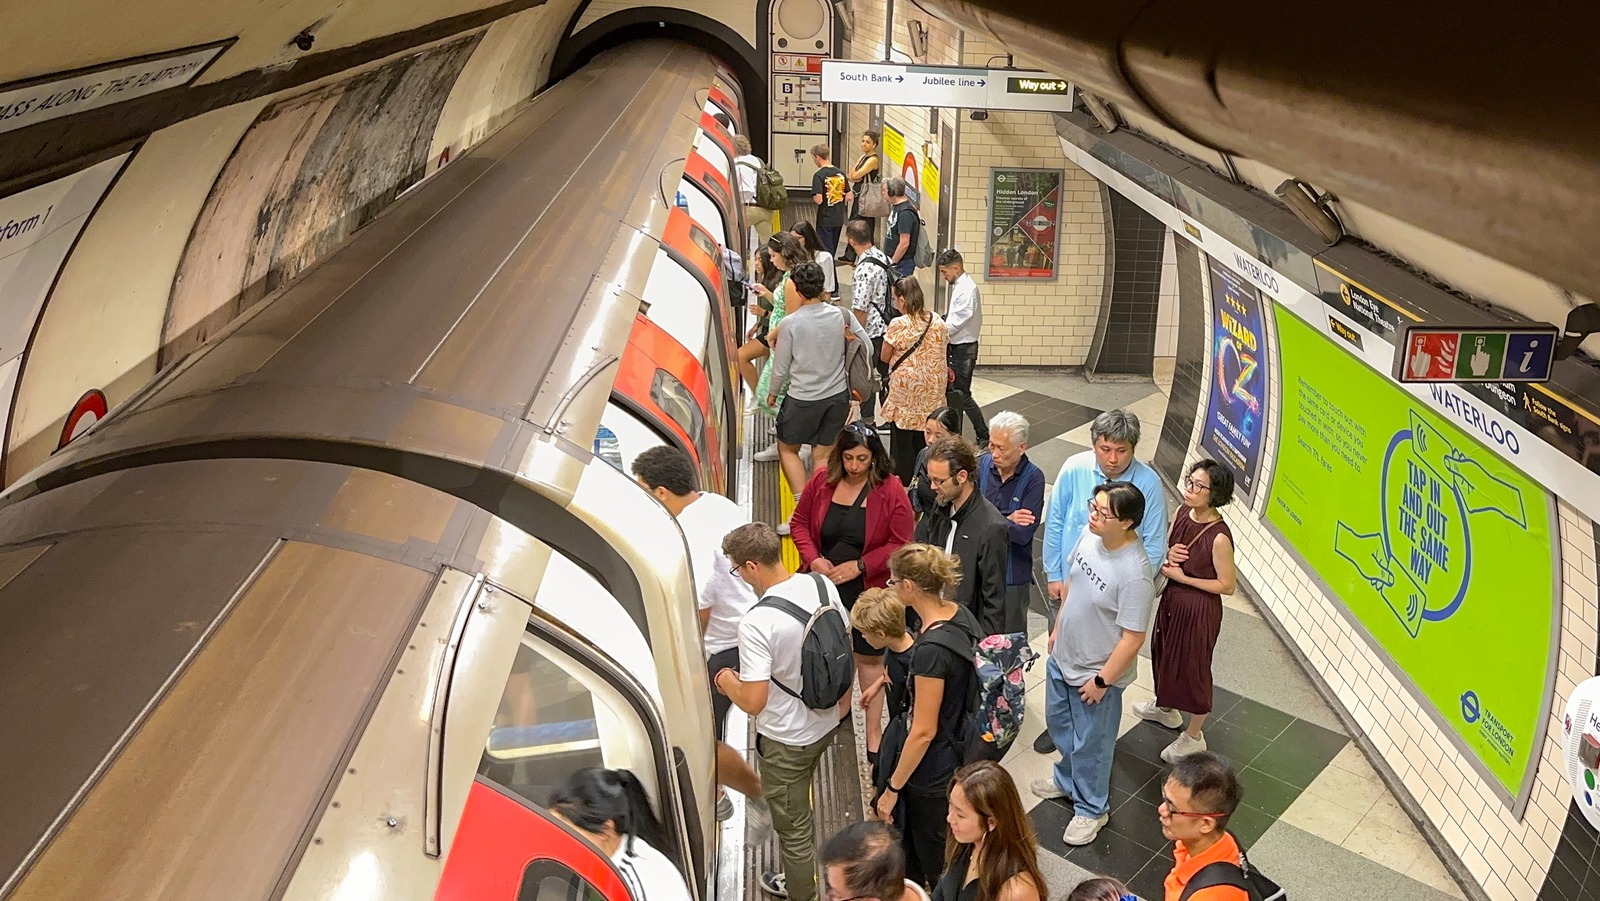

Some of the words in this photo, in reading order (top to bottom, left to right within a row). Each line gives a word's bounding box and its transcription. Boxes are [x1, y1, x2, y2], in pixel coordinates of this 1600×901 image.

[31, 83, 103, 113] ALONG
[99, 75, 137, 96] THE
[131, 61, 203, 89] PLATFORM
[784, 84, 791, 93] B
[840, 72, 868, 82] South
[871, 74, 893, 83] Bank
[922, 76, 956, 86] Jubilee
[958, 77, 976, 87] line
[1019, 79, 1040, 92] Way
[1040, 81, 1057, 91] out
[41, 204, 54, 225] 1
[1233, 251, 1279, 294] WATERLOO
[1350, 288, 1370, 308] London
[1368, 299, 1380, 314] Eye
[1352, 300, 1375, 321] National
[1373, 312, 1396, 333] Theatre
[1334, 321, 1347, 338] Way
[1346, 329, 1357, 343] out
[1298, 375, 1322, 401] Remember
[1322, 396, 1329, 407] to
[1328, 402, 1344, 418] touch
[1298, 388, 1307, 401] the
[1306, 396, 1319, 411] same
[1319, 407, 1330, 421] card
[1330, 416, 1337, 426] or
[1336, 421, 1353, 440] device
[1353, 435, 1364, 449] you
[1298, 401, 1317, 422] touched
[1335, 433, 1342, 443] so
[1342, 439, 1353, 452] you
[1352, 448, 1368, 465] never
[1429, 383, 1520, 455] WATERLOO
[1297, 434, 1312, 455] Search
[1320, 456, 1333, 474] fares
[1298, 414, 1307, 426] pay
[1306, 421, 1319, 437] more
[1319, 432, 1331, 446] than
[1331, 443, 1341, 455] you
[1341, 451, 1354, 467] need
[1407, 458, 1426, 493] TAP
[1430, 476, 1441, 508] IN
[1402, 482, 1422, 520] AND
[1427, 502, 1448, 541] OUT
[1398, 505, 1417, 544] THE
[1420, 525, 1450, 573] SAME
[1075, 552, 1107, 592] LACOSTE
[1411, 545, 1432, 586] WAY
[1481, 717, 1493, 732] FOR
[1491, 729, 1515, 756] LONDON
[1485, 709, 1514, 743] TRANSPORT
